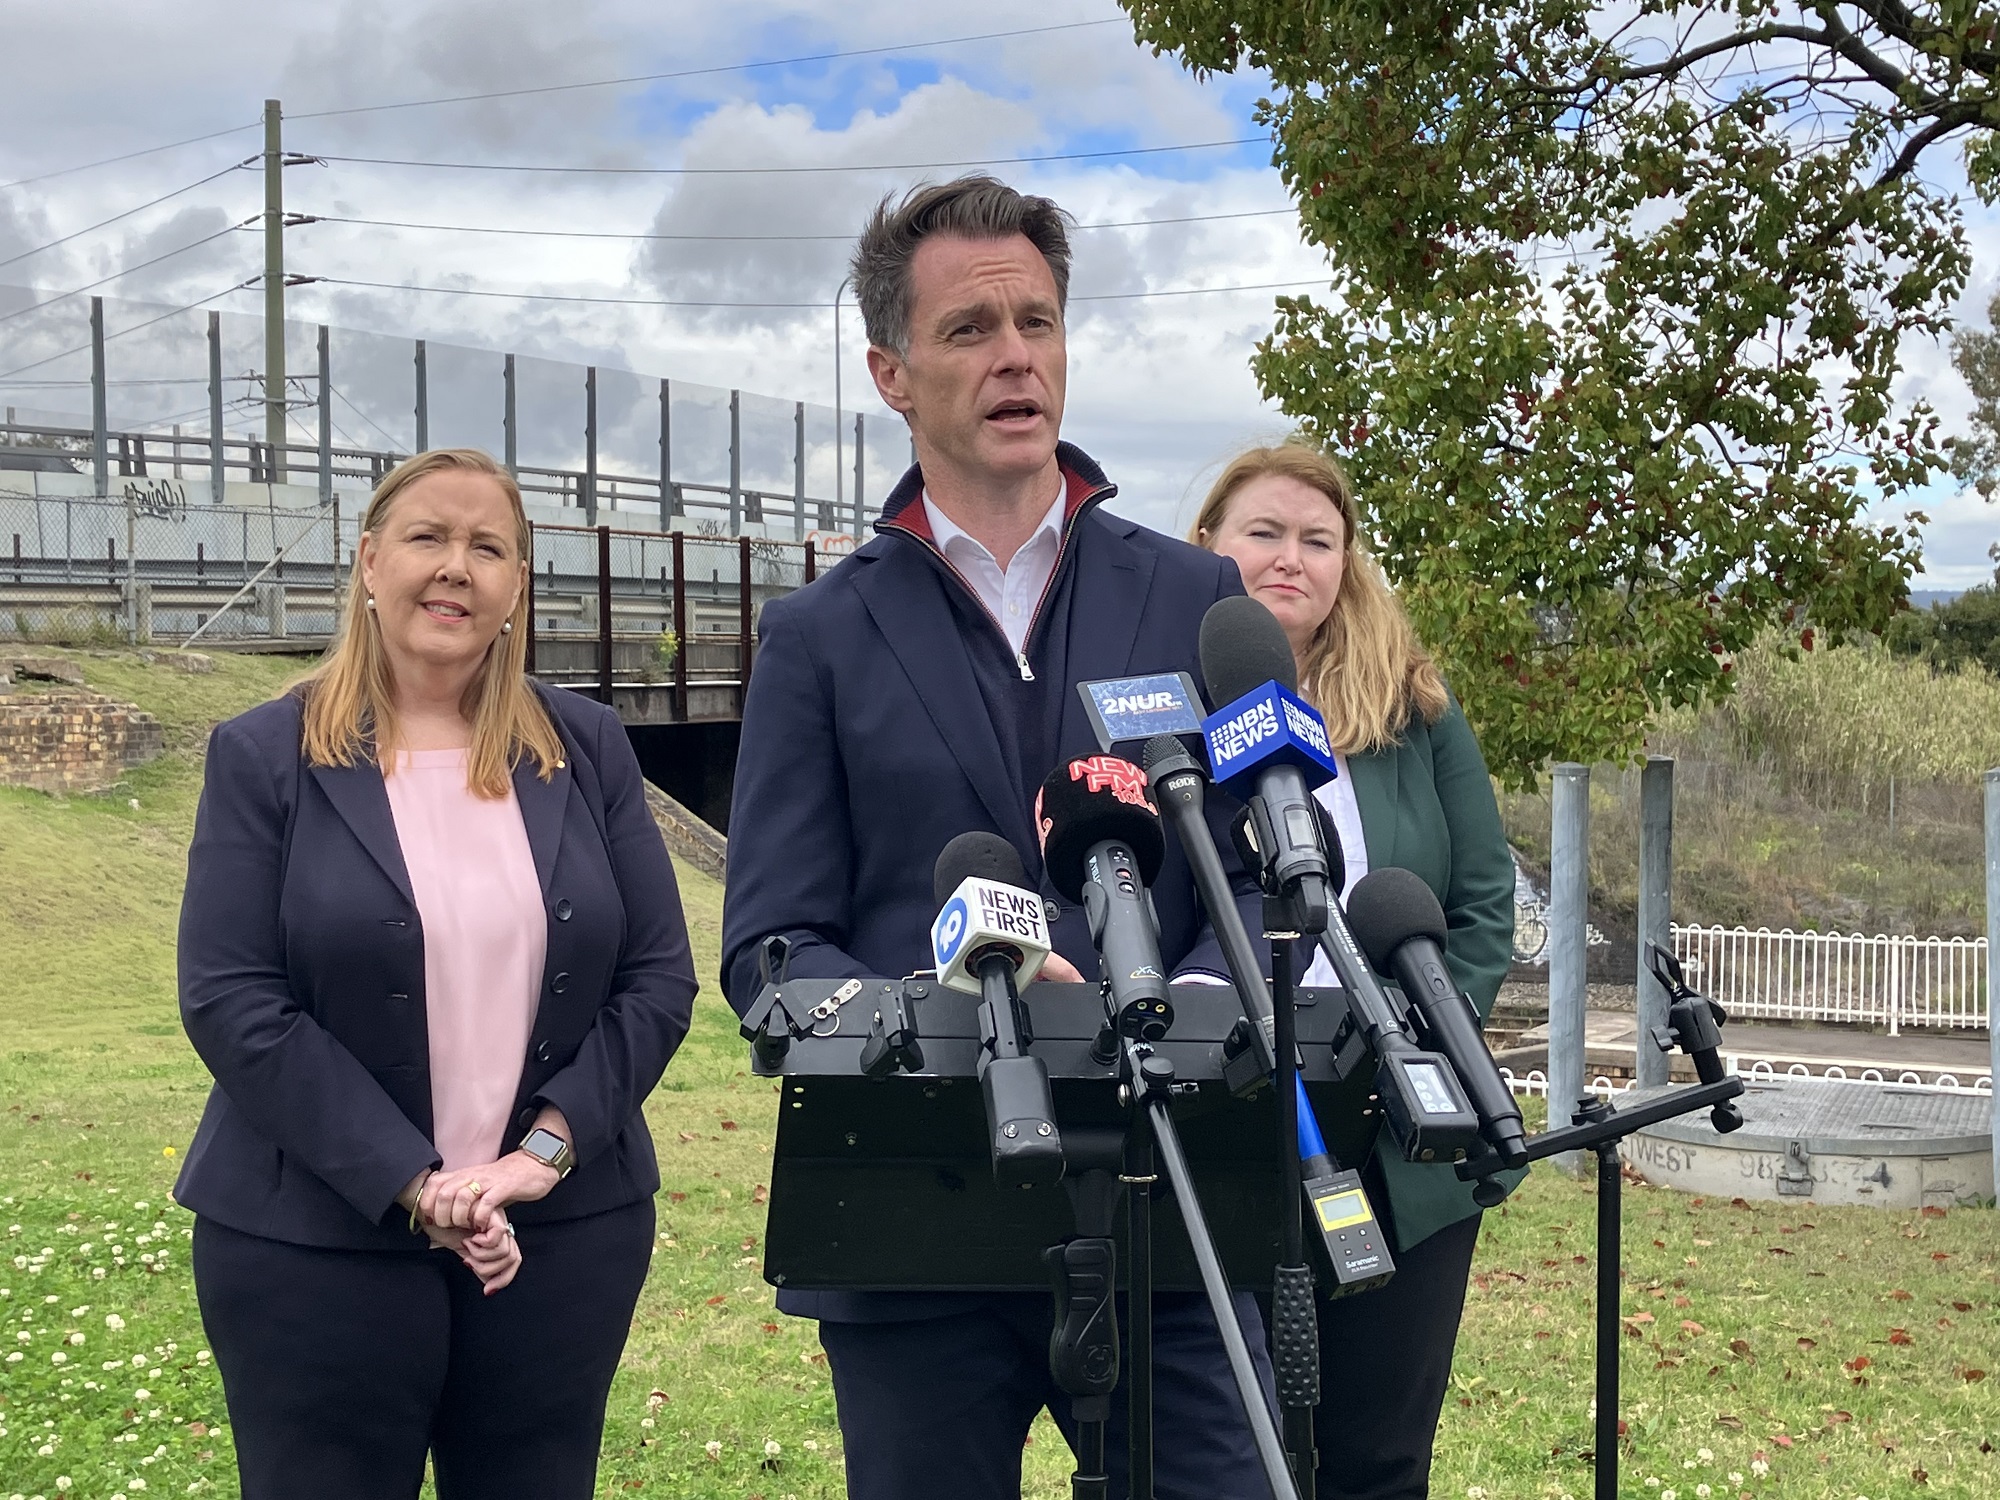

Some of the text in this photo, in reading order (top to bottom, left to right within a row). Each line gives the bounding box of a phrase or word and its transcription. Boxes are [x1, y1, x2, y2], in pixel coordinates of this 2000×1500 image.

[1102, 692, 1173, 715] 2NUR
[1227, 697, 1275, 738] NBN
[1285, 713, 1332, 758] NEWS
[1293, 704, 1327, 741] NBN
[1213, 715, 1280, 766] NEWS
[1069, 756, 1148, 787] NEW
[1087, 772, 1143, 796] FM
[978, 887, 1039, 920] NEWS
[982, 908, 1041, 940] FIRST
